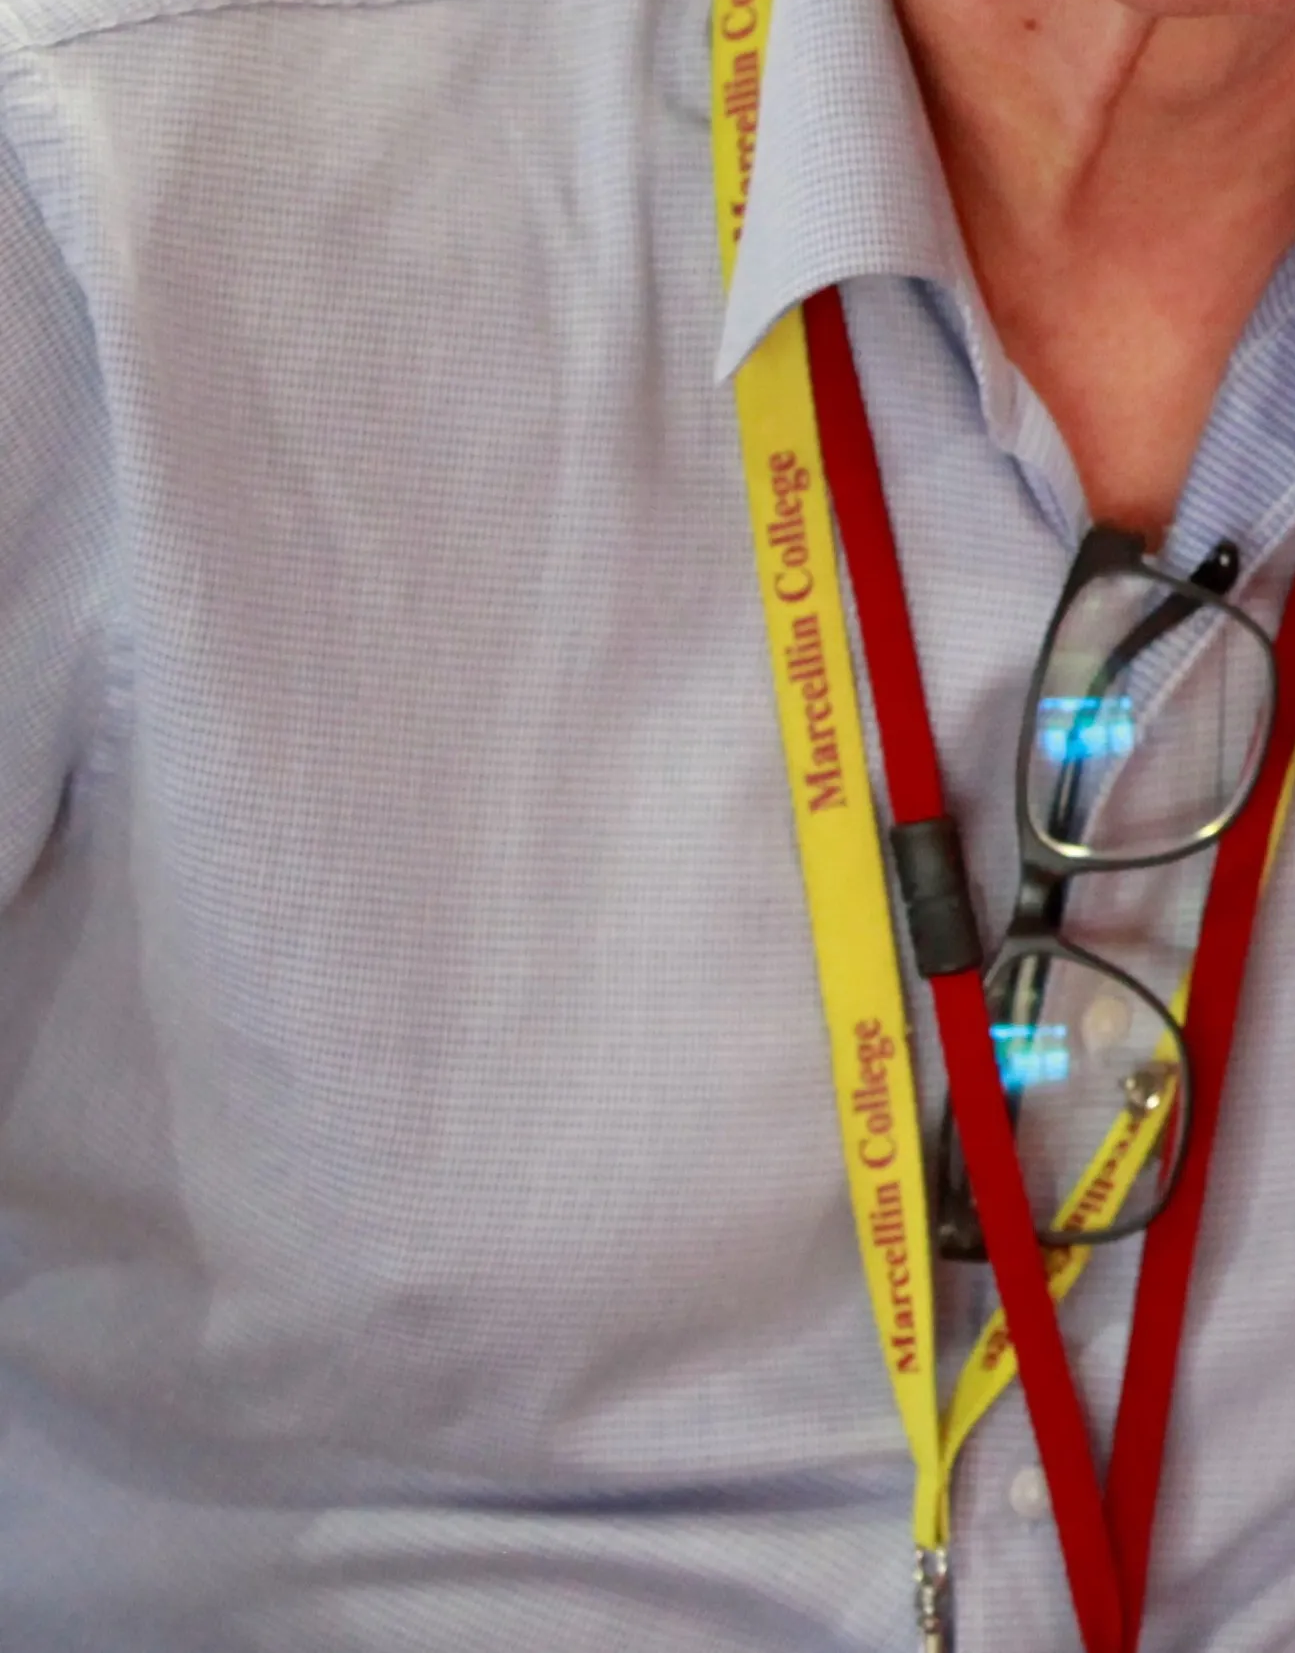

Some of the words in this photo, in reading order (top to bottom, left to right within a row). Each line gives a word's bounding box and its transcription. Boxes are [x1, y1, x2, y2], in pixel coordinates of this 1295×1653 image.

[767, 449, 814, 604] College
[785, 613, 847, 816] Marcellin
[850, 1016, 896, 1170] College
[869, 1180, 920, 1375] Marcellin
